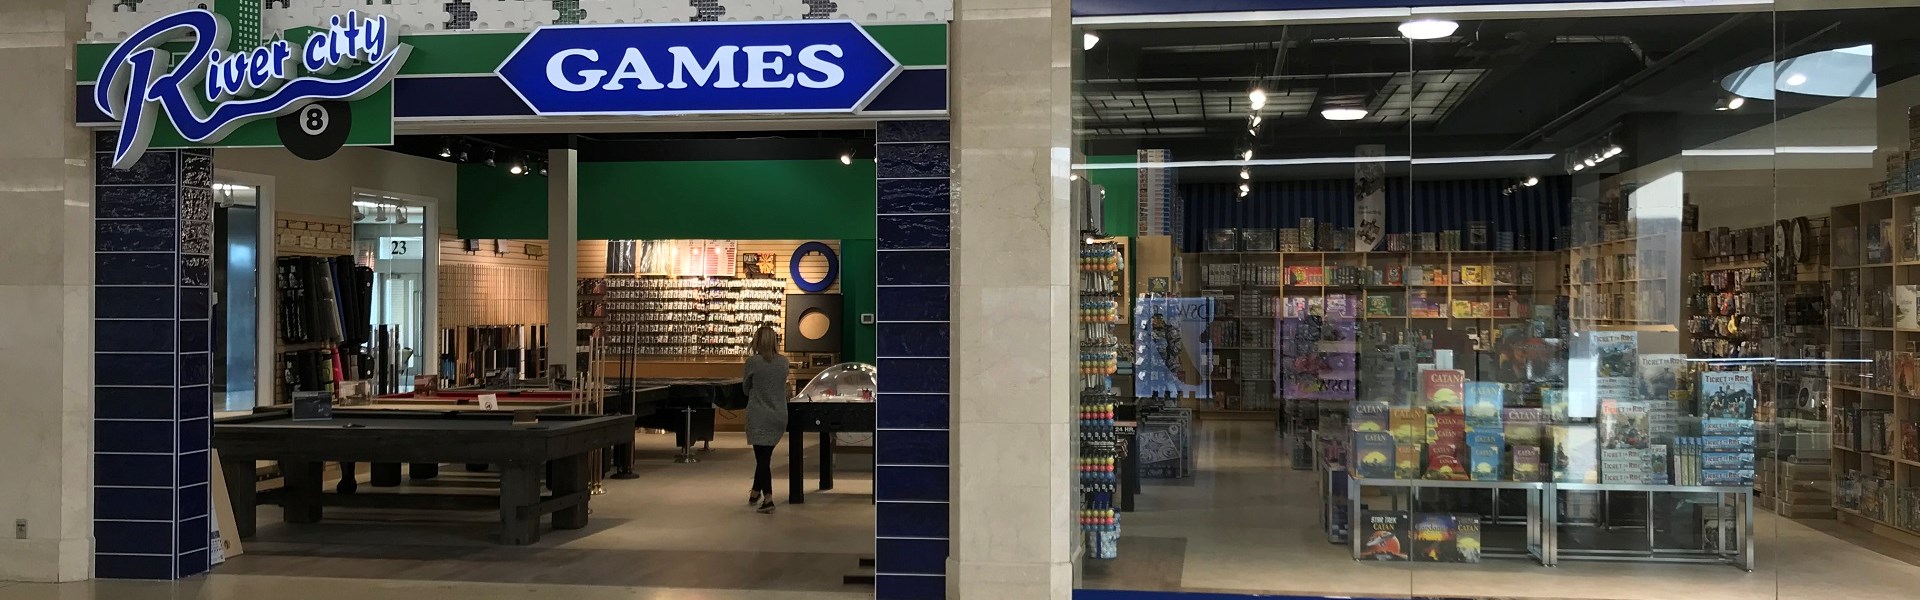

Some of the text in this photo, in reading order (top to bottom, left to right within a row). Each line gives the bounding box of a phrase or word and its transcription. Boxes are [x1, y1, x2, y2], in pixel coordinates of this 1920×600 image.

[545, 43, 846, 92] GAMES
[95, 9, 388, 168] River city
[305, 108, 323, 132] 8
[391, 240, 407, 256] 23
[1431, 373, 1461, 383] CATAN
[1356, 404, 1383, 414] CATAN
[1437, 417, 1457, 425] CATAN
[1509, 411, 1536, 421] CATAN
[1364, 433, 1386, 441] CATAN
[1437, 430, 1457, 438] CATAN
[1371, 516, 1397, 524] STAR TREK
[1373, 523, 1395, 531] CATAN
[1458, 524, 1479, 532] CATAN
